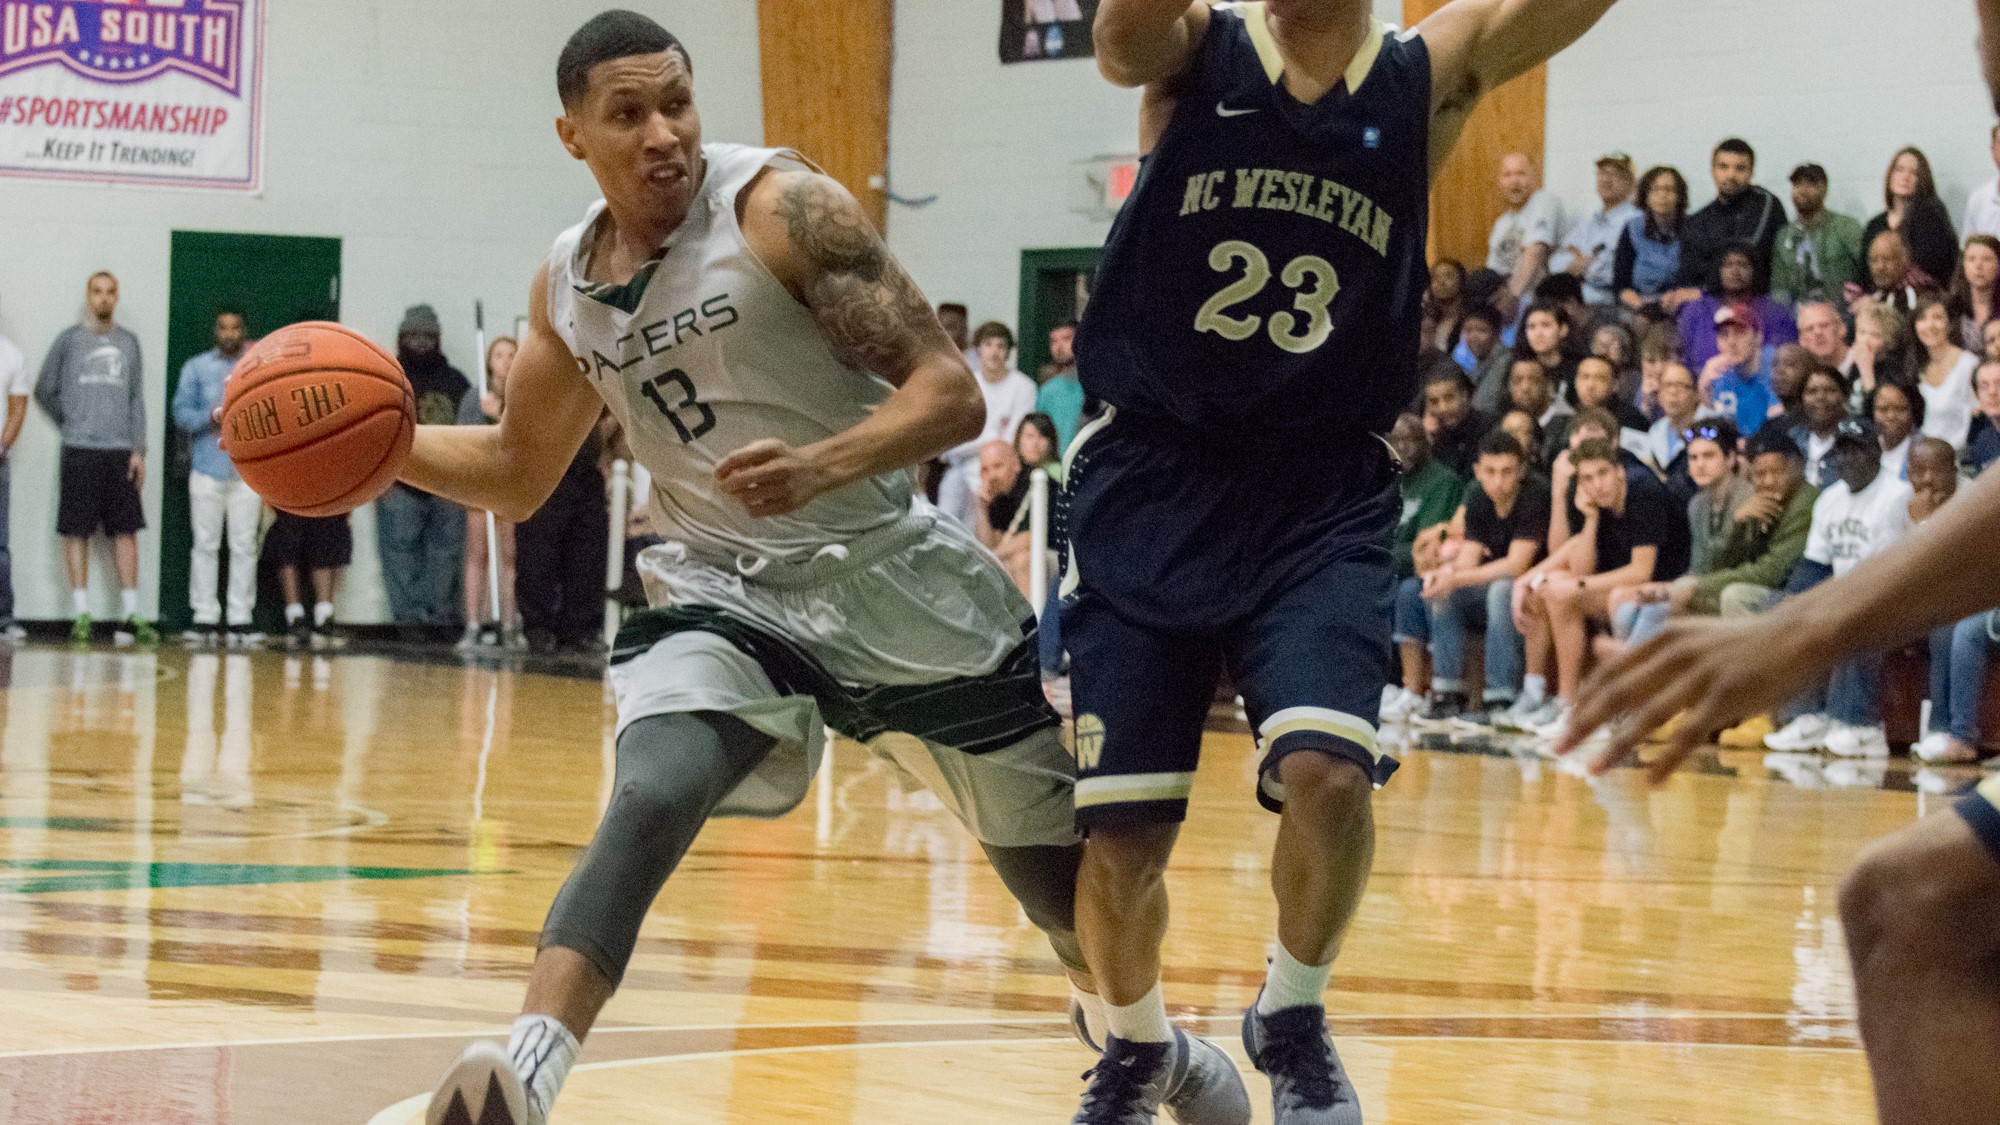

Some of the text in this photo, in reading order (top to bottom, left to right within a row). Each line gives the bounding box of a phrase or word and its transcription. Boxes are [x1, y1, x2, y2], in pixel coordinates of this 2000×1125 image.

[4, 2, 227, 68] USA SOUTH
[0, 96, 228, 136] #SPORTSMANSHIP
[1179, 170, 1226, 217] NC
[1232, 168, 1393, 258] WESLEYAN
[1194, 240, 1341, 354] 23
[231, 383, 350, 442] THE ROCK
[641, 368, 716, 444] 13
